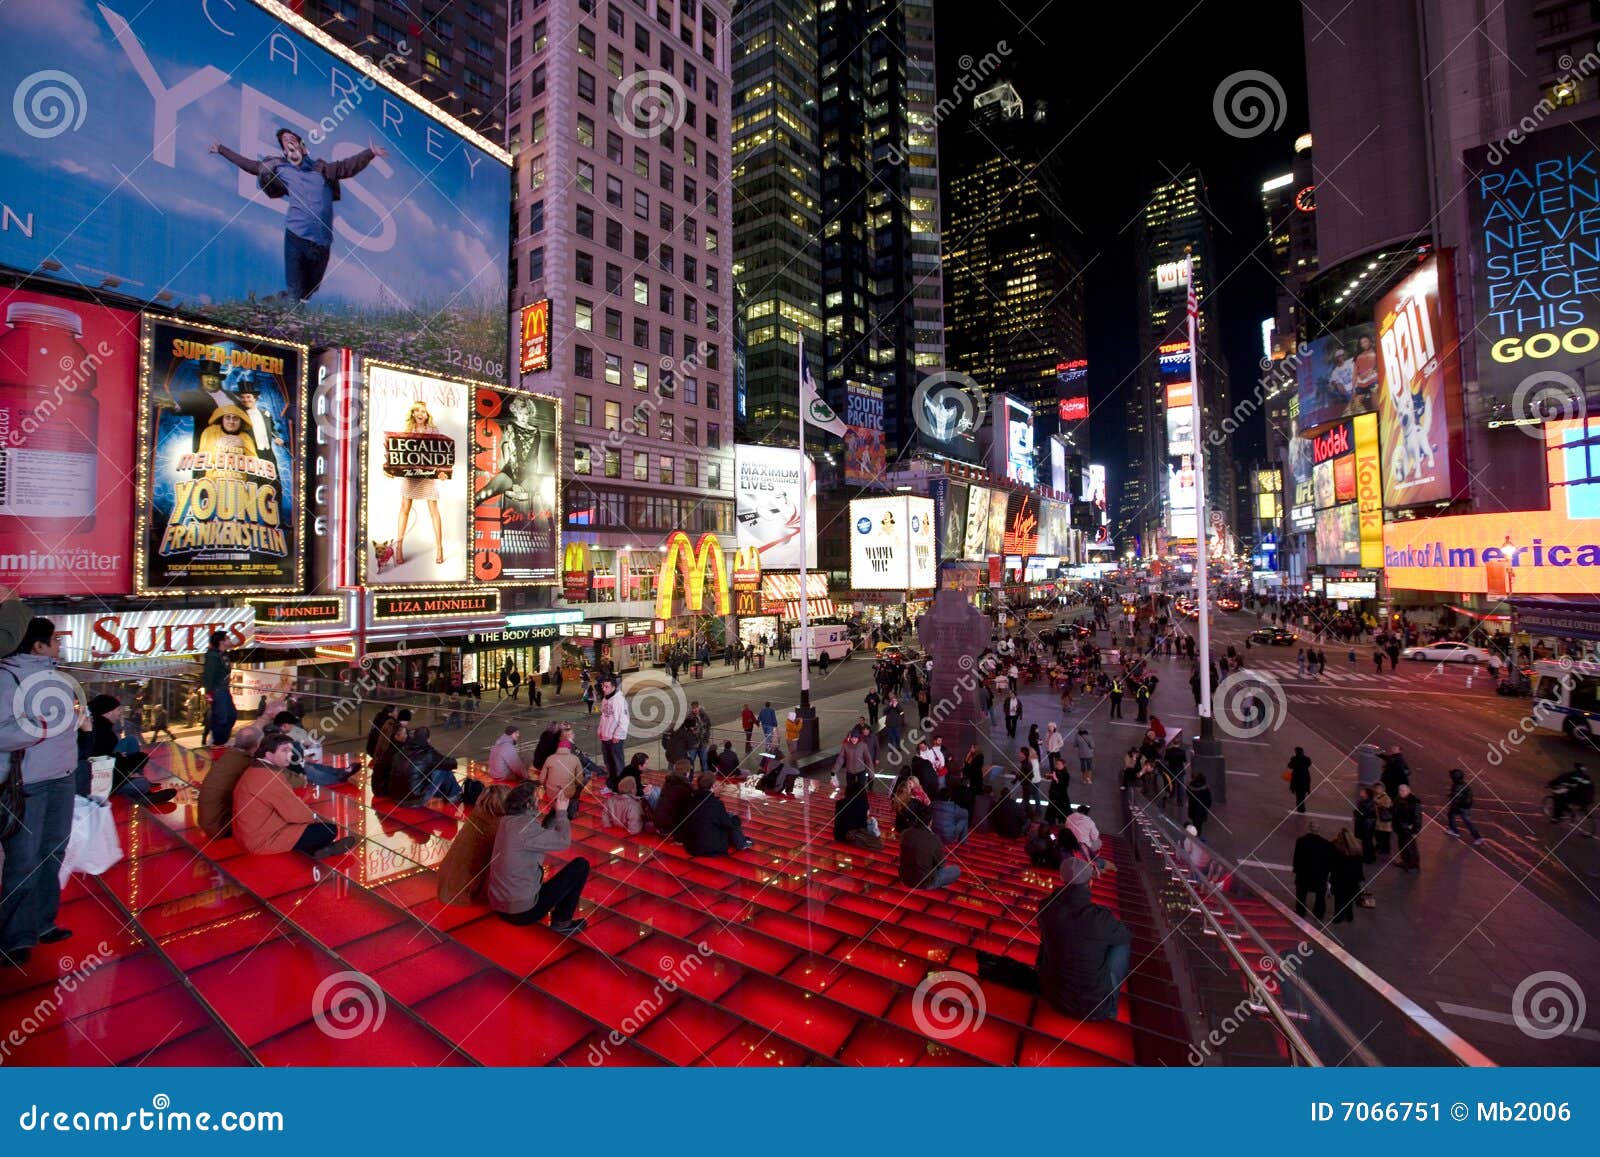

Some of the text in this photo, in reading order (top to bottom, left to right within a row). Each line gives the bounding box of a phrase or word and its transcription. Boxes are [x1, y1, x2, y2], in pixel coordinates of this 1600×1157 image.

[97, 3, 397, 252] YES
[1481, 150, 1597, 199] PARK
[1490, 267, 1600, 308] FACE
[1489, 300, 1584, 335] THIS
[172, 338, 284, 376] SUPER-DUPER!
[447, 348, 504, 379] 12.19.08
[848, 395, 884, 416] SOUTH
[848, 409, 884, 430] PACIFIC
[314, 365, 327, 536] PALACE
[389, 438, 454, 451] LEGALLY
[390, 451, 454, 467] BLONDE
[1313, 425, 1348, 463] Kodak
[176, 451, 213, 471] MEL
[741, 467, 799, 478] MAXIMUM
[741, 481, 775, 491] LIVES
[1358, 455, 1377, 528] Kodak
[169, 477, 281, 527] YOUNG
[159, 520, 288, 557] FRANKENSTEIN
[1385, 538, 1600, 567] Bank of America
[281, 606, 336, 617] MINNELLI
[390, 598, 487, 613] LIZA MINNELLI
[480, 628, 556, 642] THE BODY SHOP
